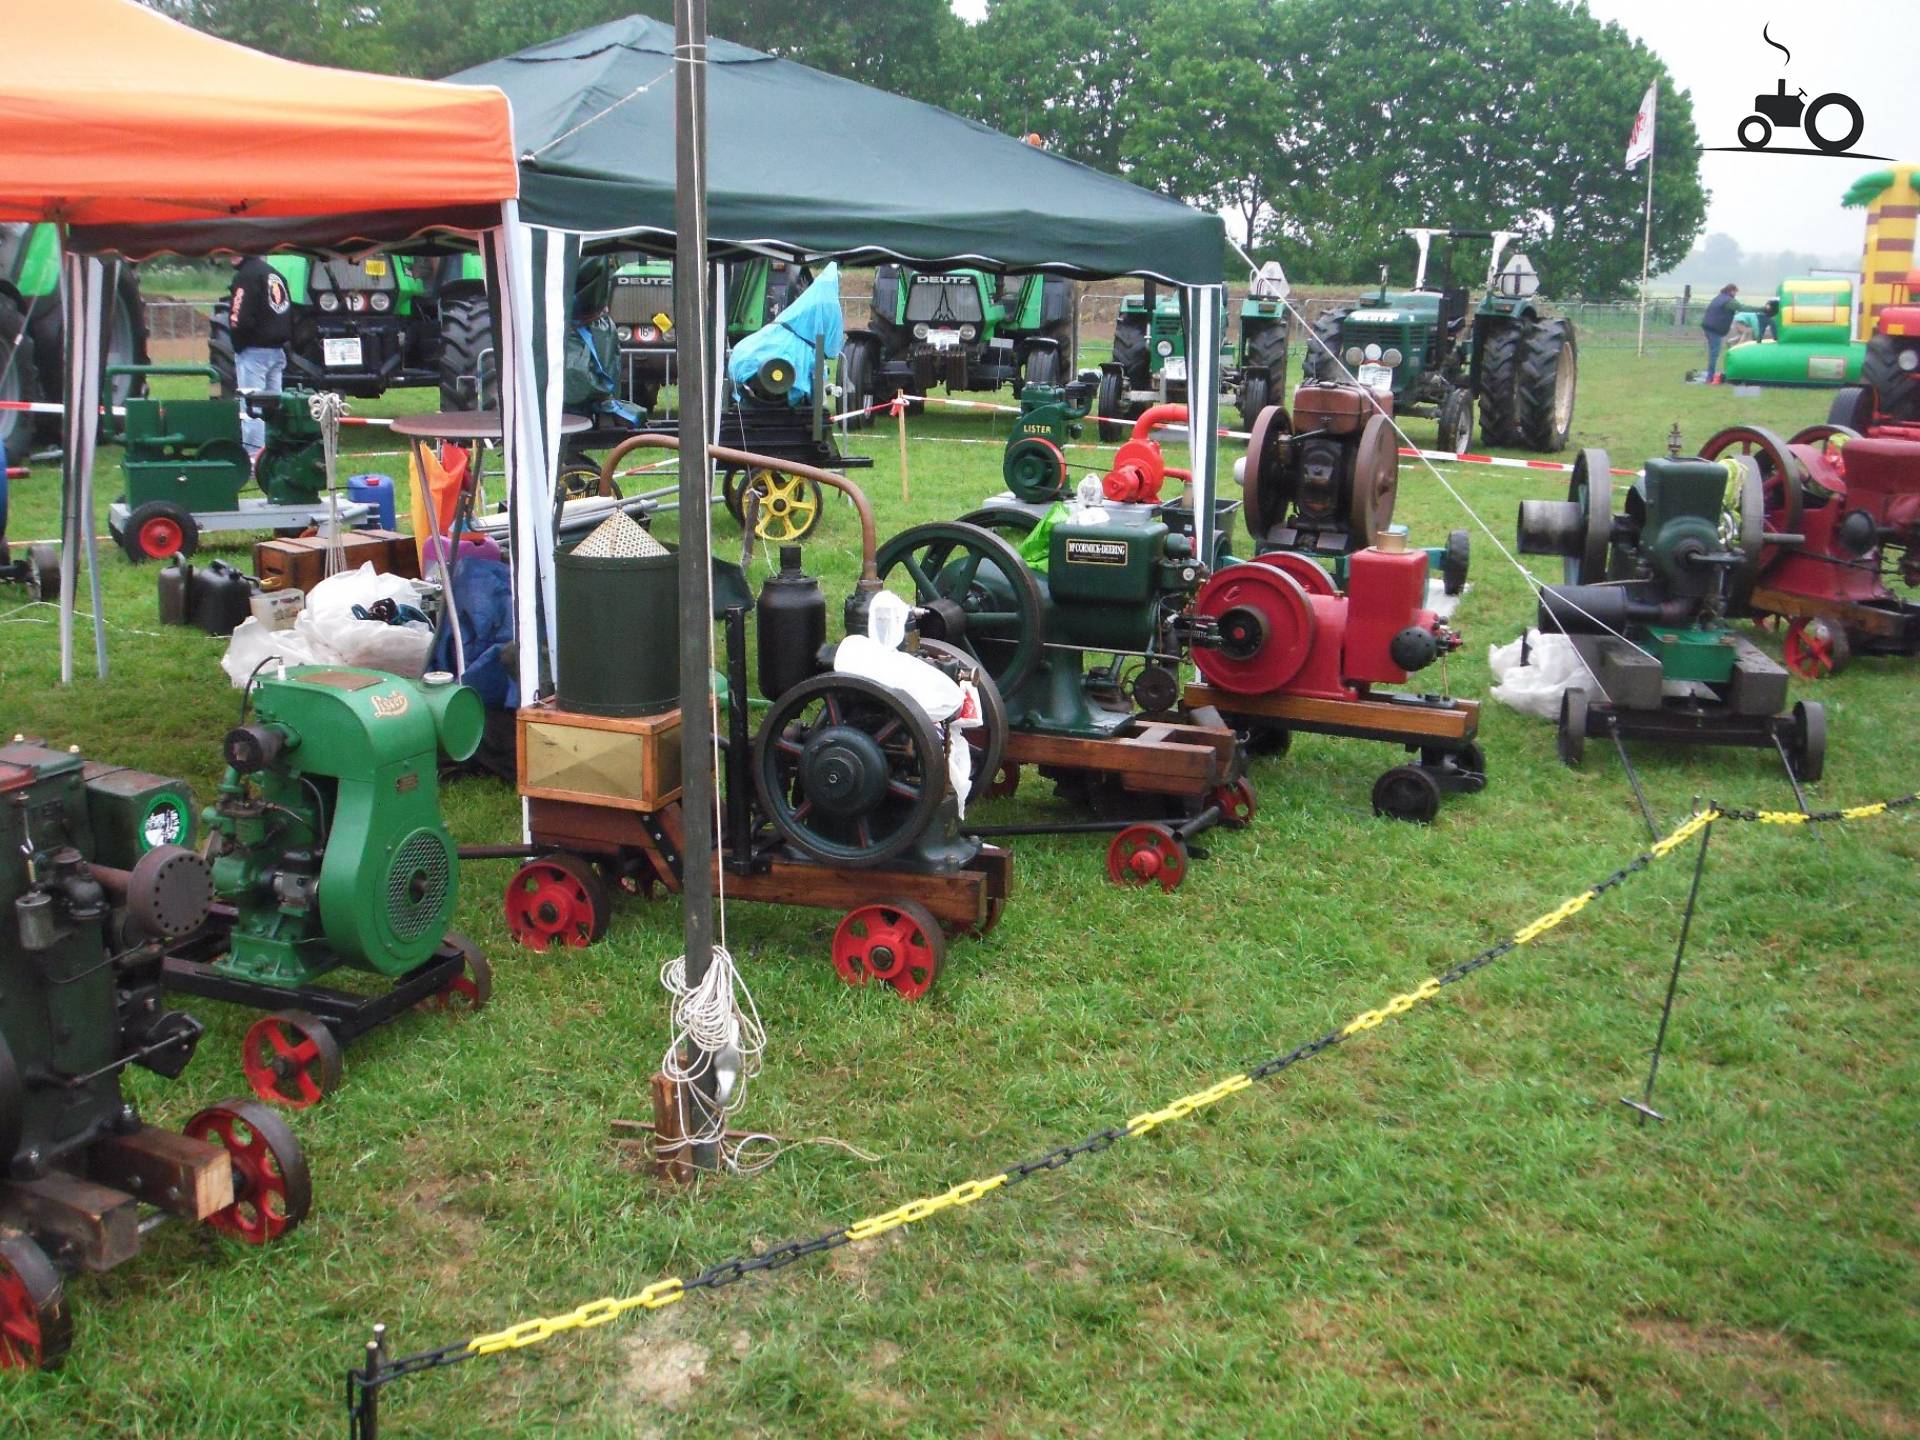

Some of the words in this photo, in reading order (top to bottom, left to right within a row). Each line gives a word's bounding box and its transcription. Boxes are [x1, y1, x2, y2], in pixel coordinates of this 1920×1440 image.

[618, 277, 672, 285] DEUTZ
[917, 276, 971, 284] DEUTZ
[1023, 424, 1052, 434] LISTER
